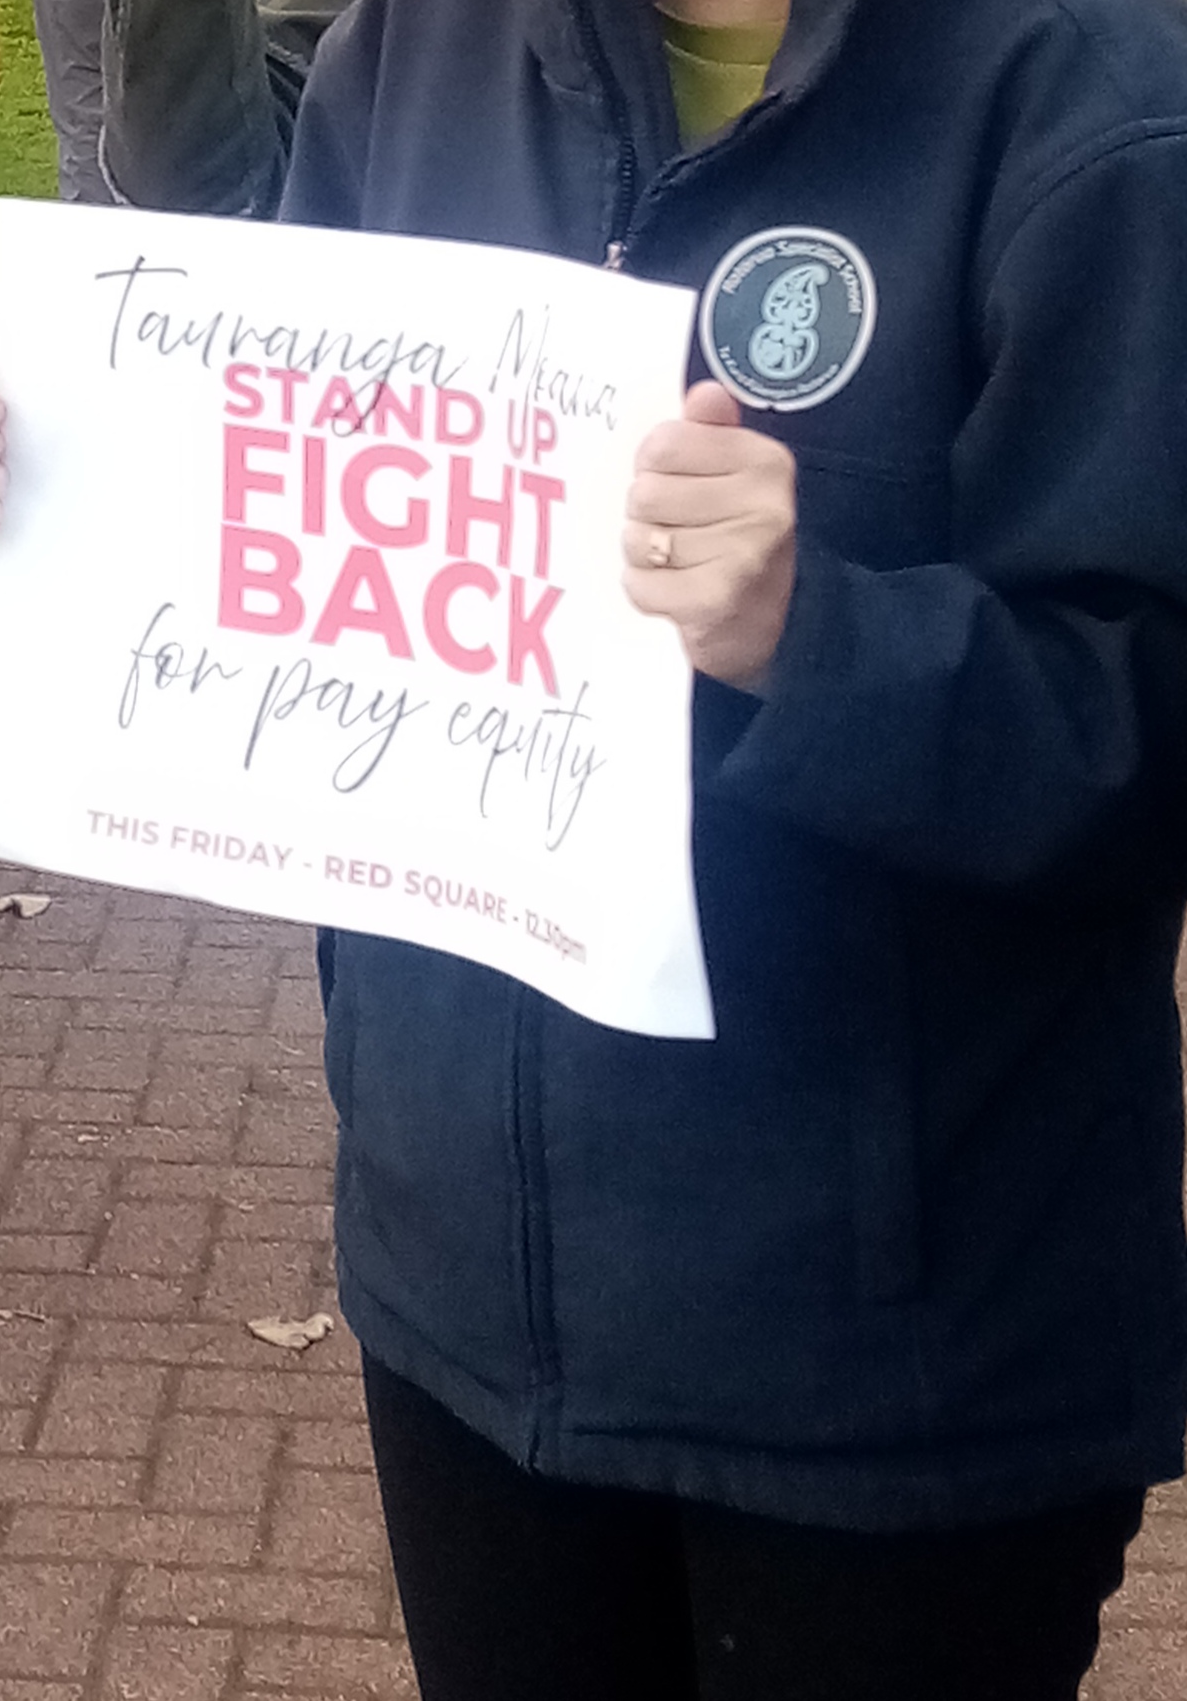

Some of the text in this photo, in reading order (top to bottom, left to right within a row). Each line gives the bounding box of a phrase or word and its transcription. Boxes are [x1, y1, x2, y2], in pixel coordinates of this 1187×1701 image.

[95, 255, 469, 438] Tauranga
[222, 361, 558, 465] STAND UP
[220, 422, 567, 581] FIGHT
[217, 522, 566, 700] BACK
[118, 602, 607, 853] for pay equity
[86, 809, 160, 847] THIS
[169, 825, 294, 872] FRIDAY
[323, 854, 393, 890] RED
[403, 868, 508, 925] SQUARE
